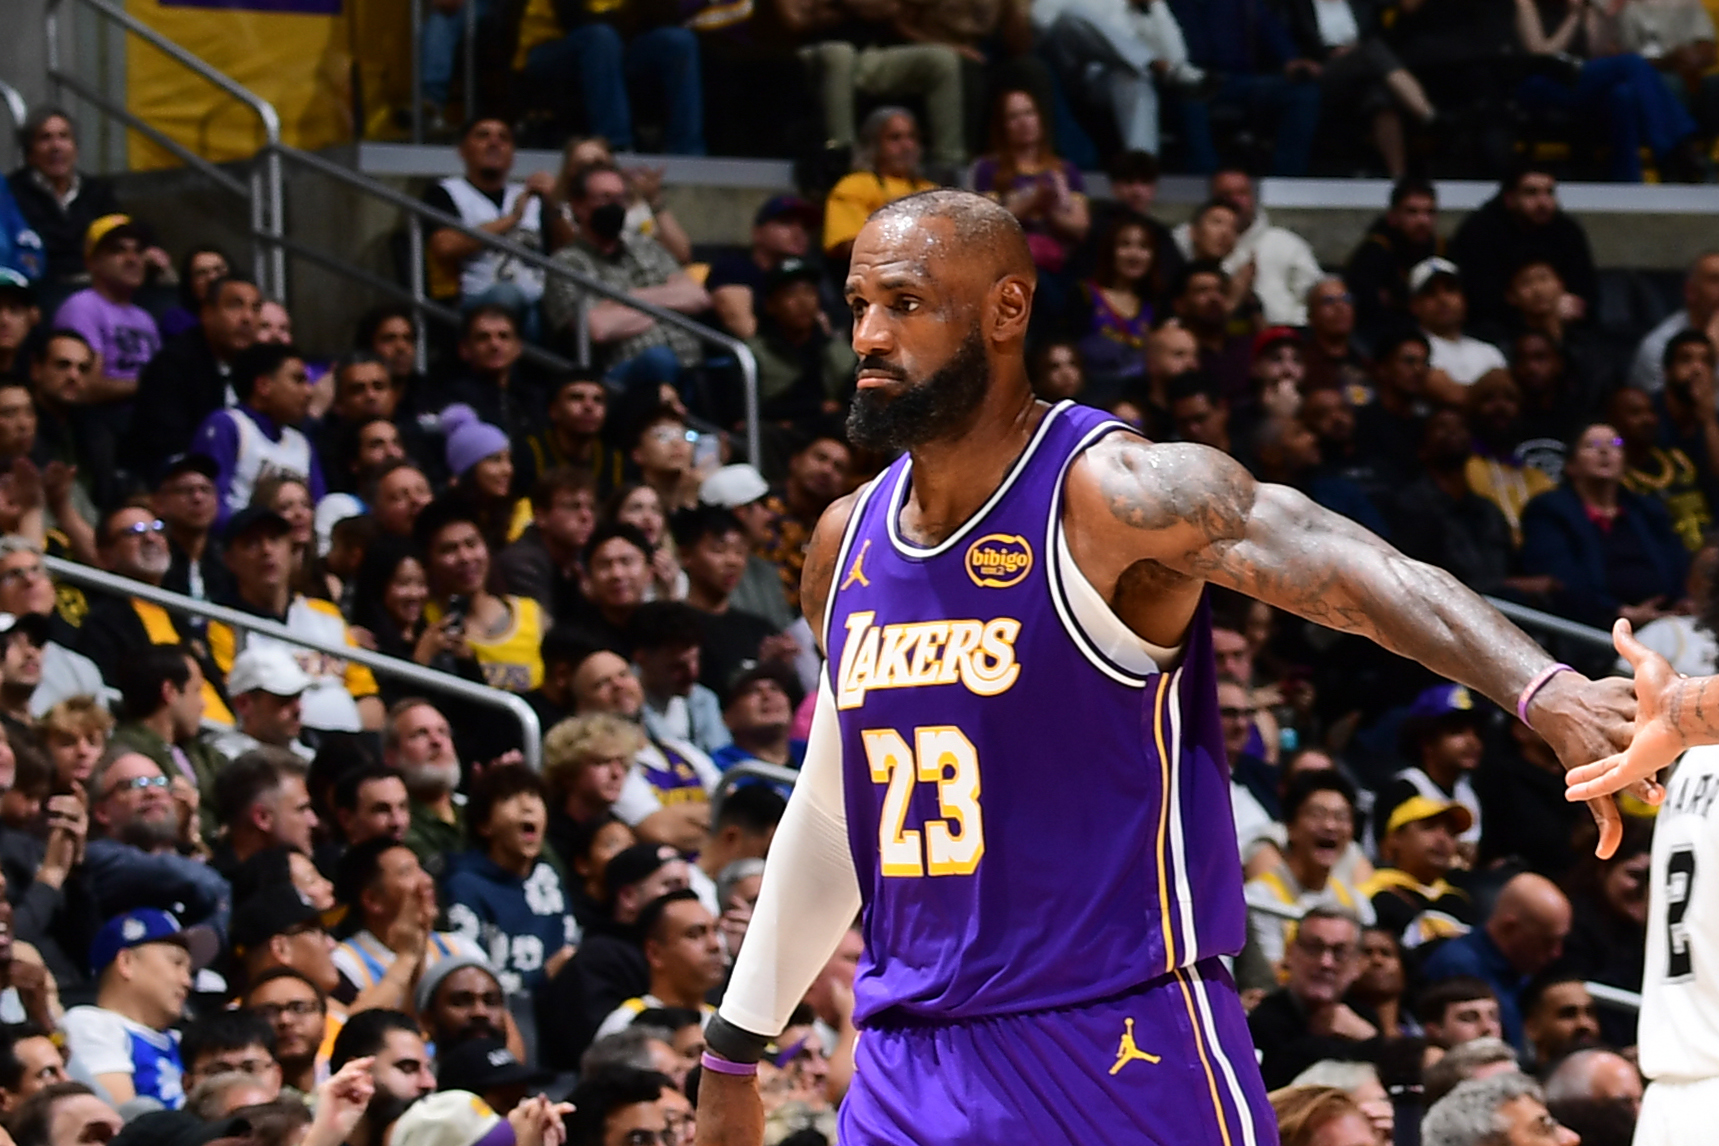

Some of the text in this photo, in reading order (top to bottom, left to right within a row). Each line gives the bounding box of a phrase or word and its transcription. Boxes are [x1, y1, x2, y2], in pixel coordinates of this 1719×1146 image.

[972, 547, 1028, 573] bibigo
[837, 610, 1022, 711] LAKERS
[861, 725, 985, 877] 23
[1663, 843, 1697, 975] 2
